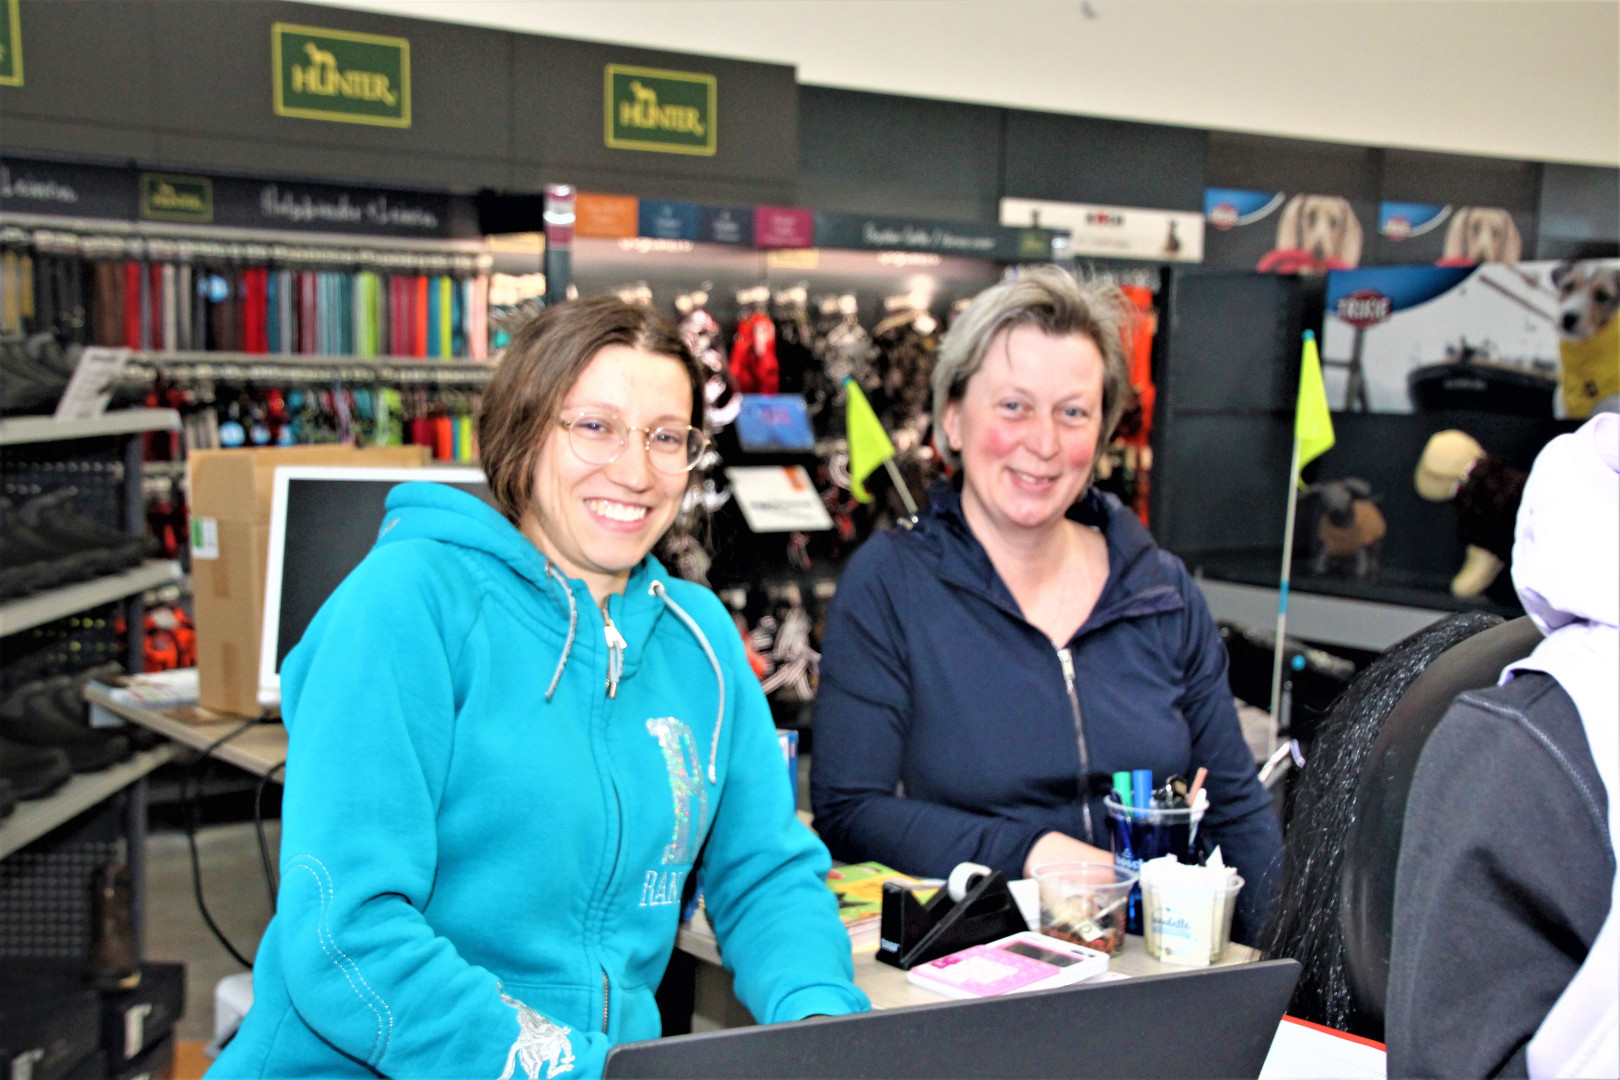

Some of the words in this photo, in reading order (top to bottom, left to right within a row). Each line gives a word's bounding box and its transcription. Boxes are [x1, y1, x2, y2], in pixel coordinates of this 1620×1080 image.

[291, 62, 396, 107] HUNTER
[619, 100, 704, 136] HUNTER
[638, 869, 689, 907] RAN
